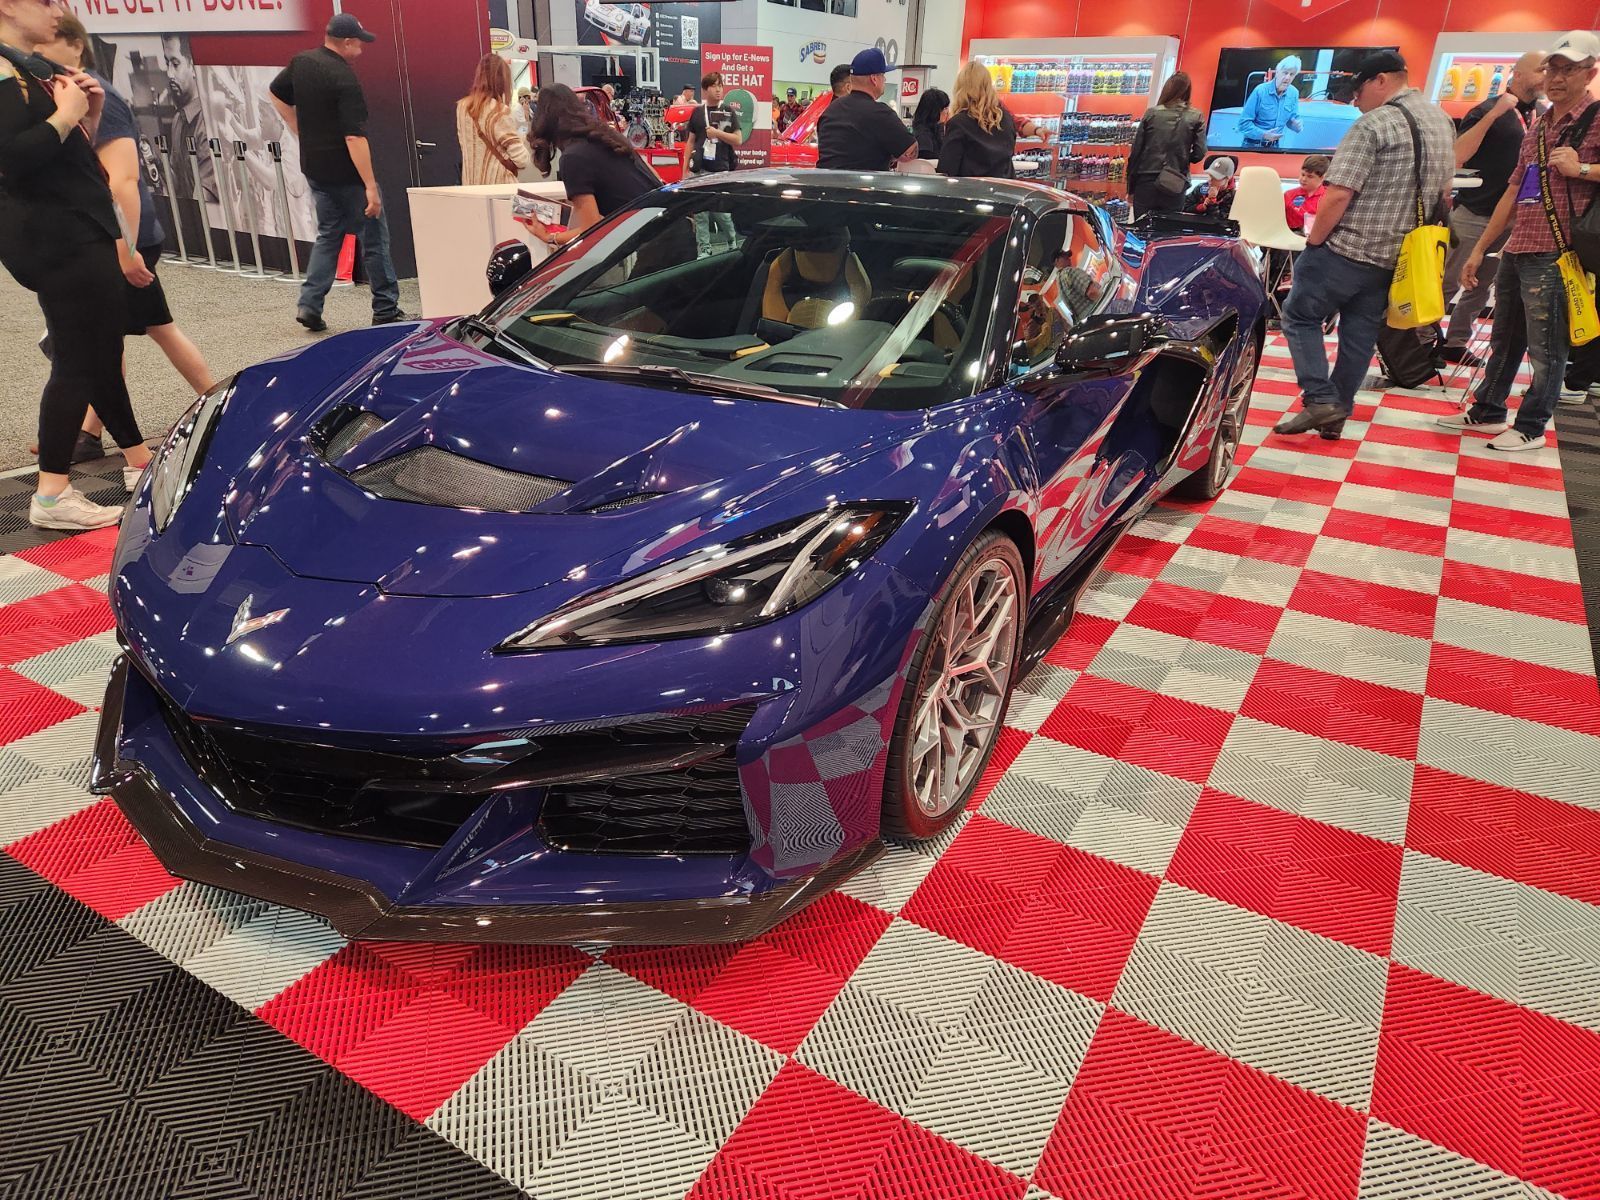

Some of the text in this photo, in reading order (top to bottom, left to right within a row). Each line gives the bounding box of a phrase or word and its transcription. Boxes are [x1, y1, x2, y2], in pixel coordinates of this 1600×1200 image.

[705, 52, 720, 62] Sign
[721, 52, 731, 63] Up
[732, 52, 743, 61] for
[743, 53, 770, 63] E-News
[721, 63, 735, 71] And
[736, 63, 748, 72] Get
[720, 73, 765, 87] REE HAT
